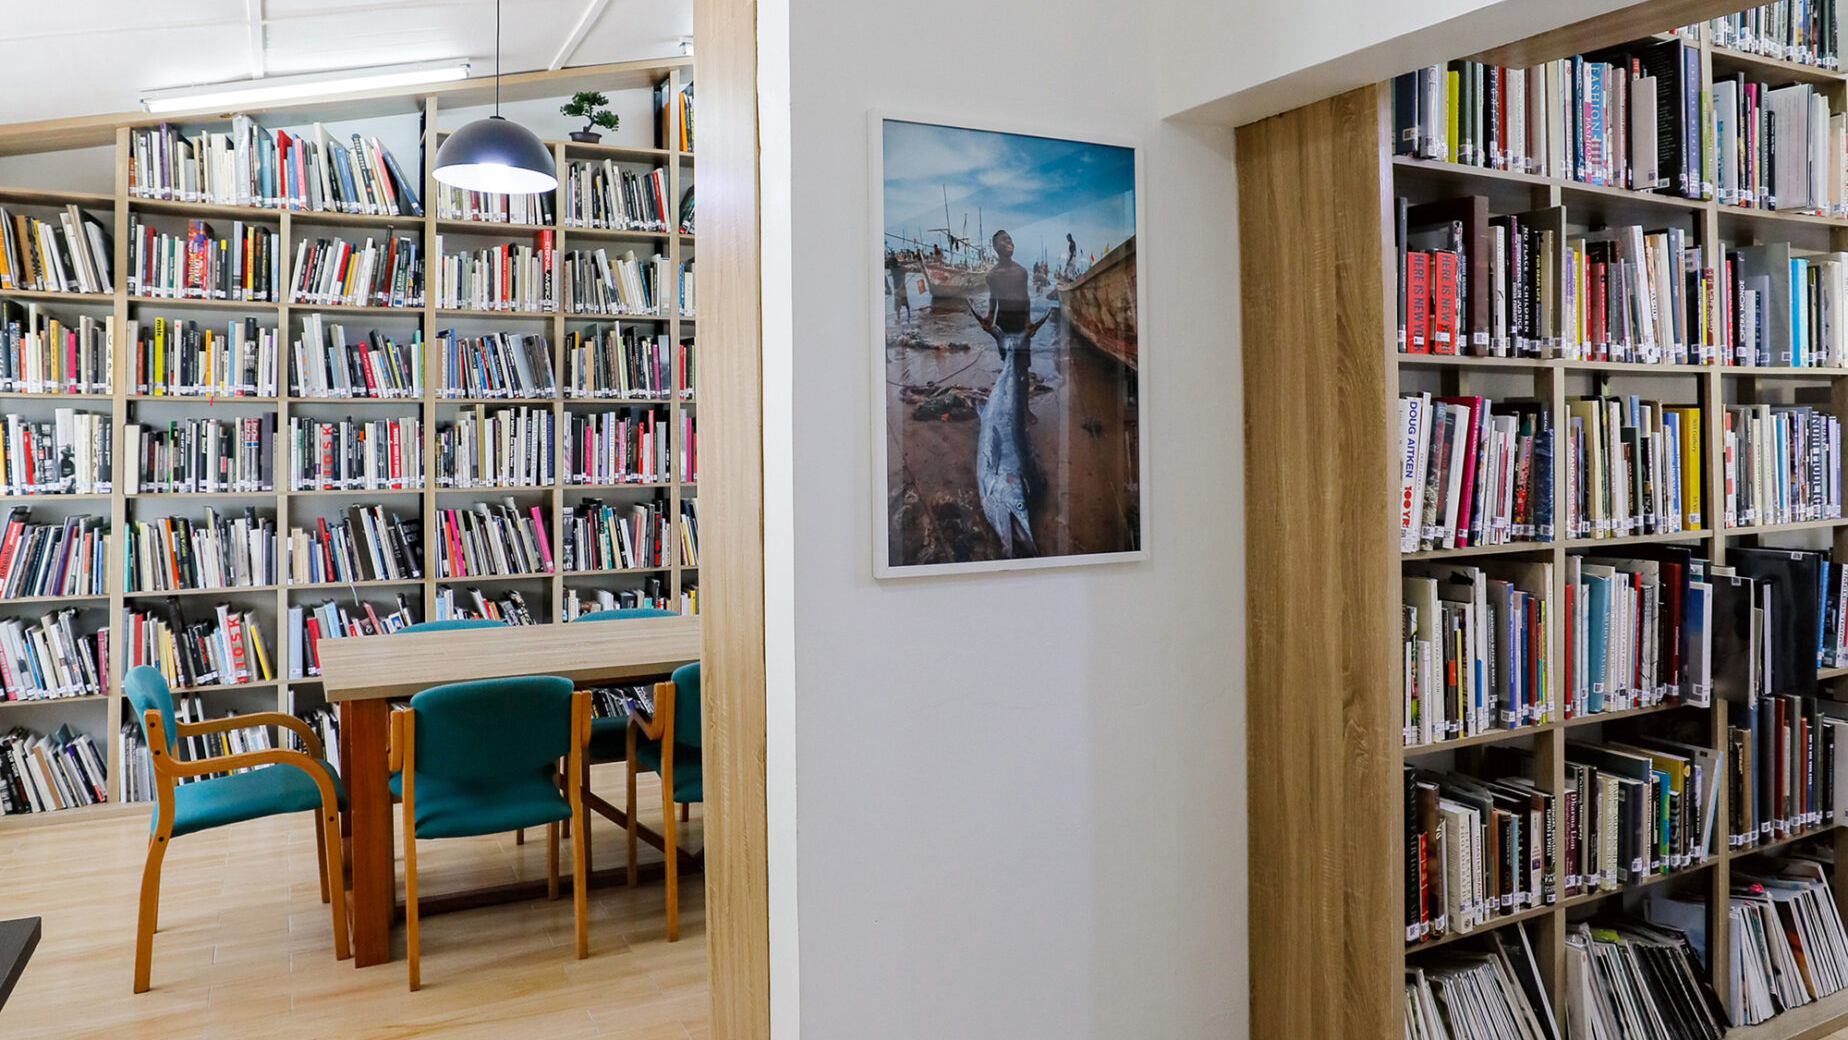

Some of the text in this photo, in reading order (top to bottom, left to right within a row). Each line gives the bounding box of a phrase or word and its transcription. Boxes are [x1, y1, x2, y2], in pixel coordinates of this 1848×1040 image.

[1590, 66, 1601, 132] FASHION
[1524, 227, 1529, 241] NO
[1441, 254, 1451, 281] HERE
[1441, 285, 1451, 295] IS
[1517, 289, 1523, 298] IN
[1413, 254, 1424, 352] HERE IS NEW YOK
[1441, 298, 1451, 321] NEW
[1408, 401, 1418, 434] DOUG
[1405, 438, 1415, 478] AITKEN
[1403, 486, 1413, 508] 100
